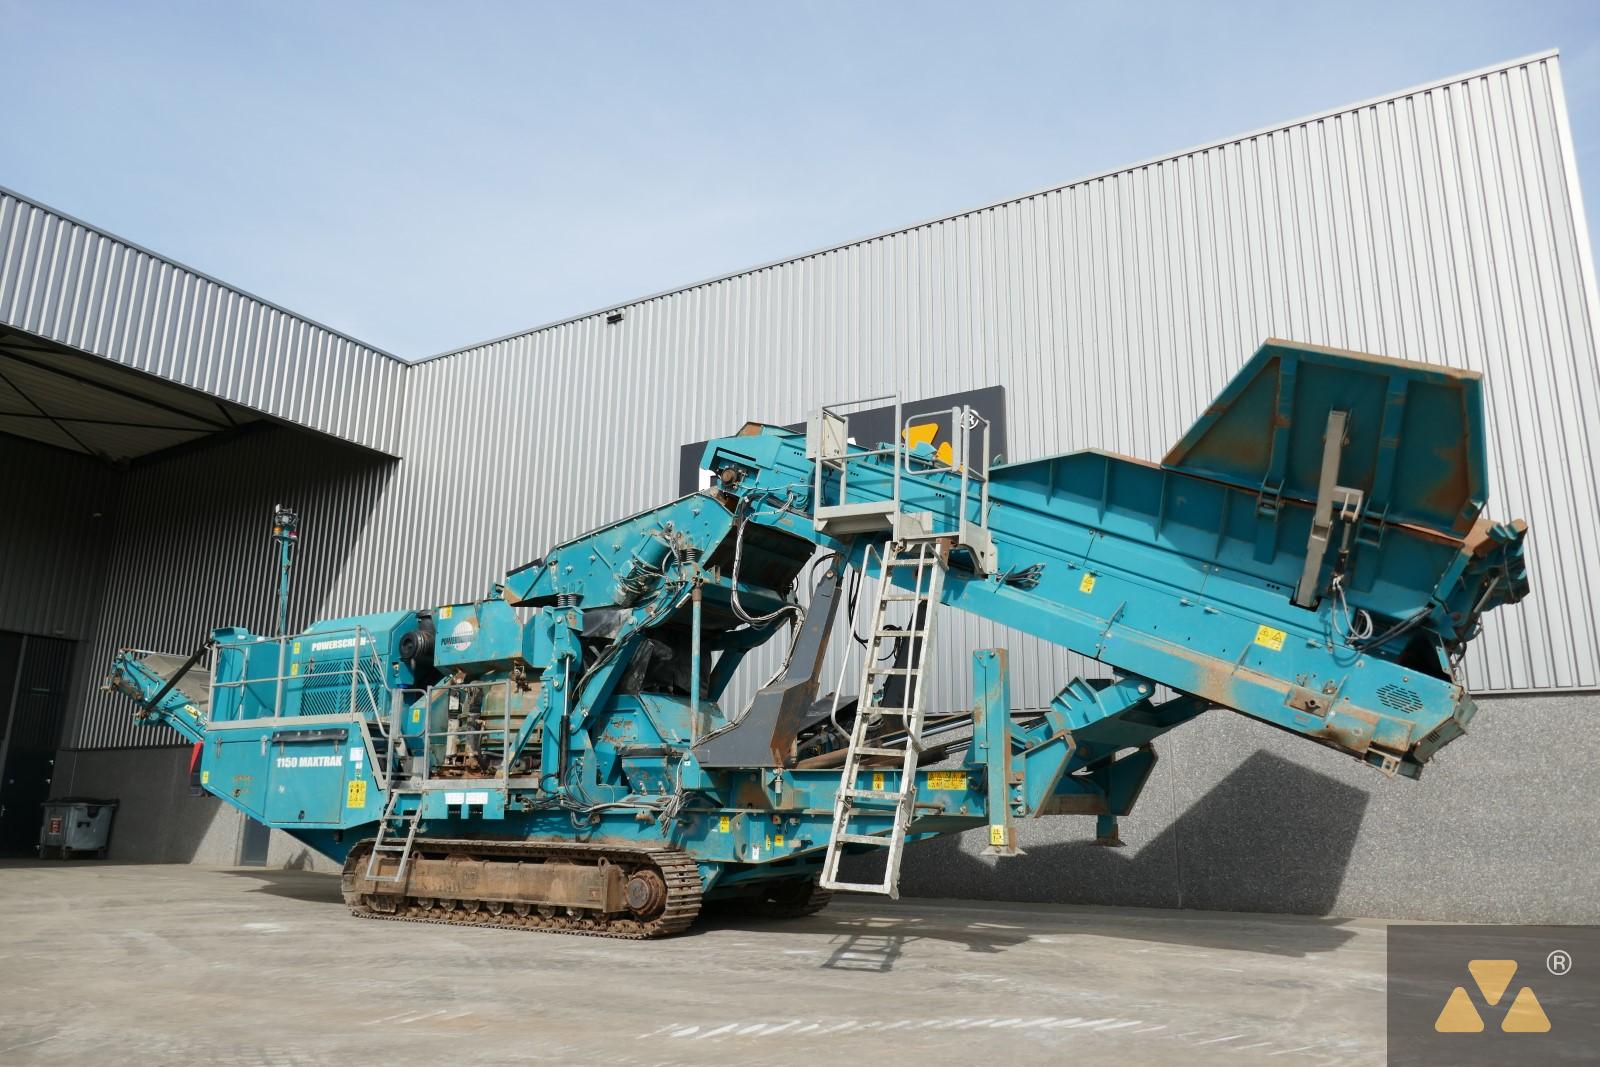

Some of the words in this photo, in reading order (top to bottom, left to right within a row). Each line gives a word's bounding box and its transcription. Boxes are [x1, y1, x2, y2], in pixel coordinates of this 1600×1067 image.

[312, 637, 367, 652] POWERSCREN
[276, 756, 298, 768] 1150
[299, 755, 343, 767] MAXTRAK
